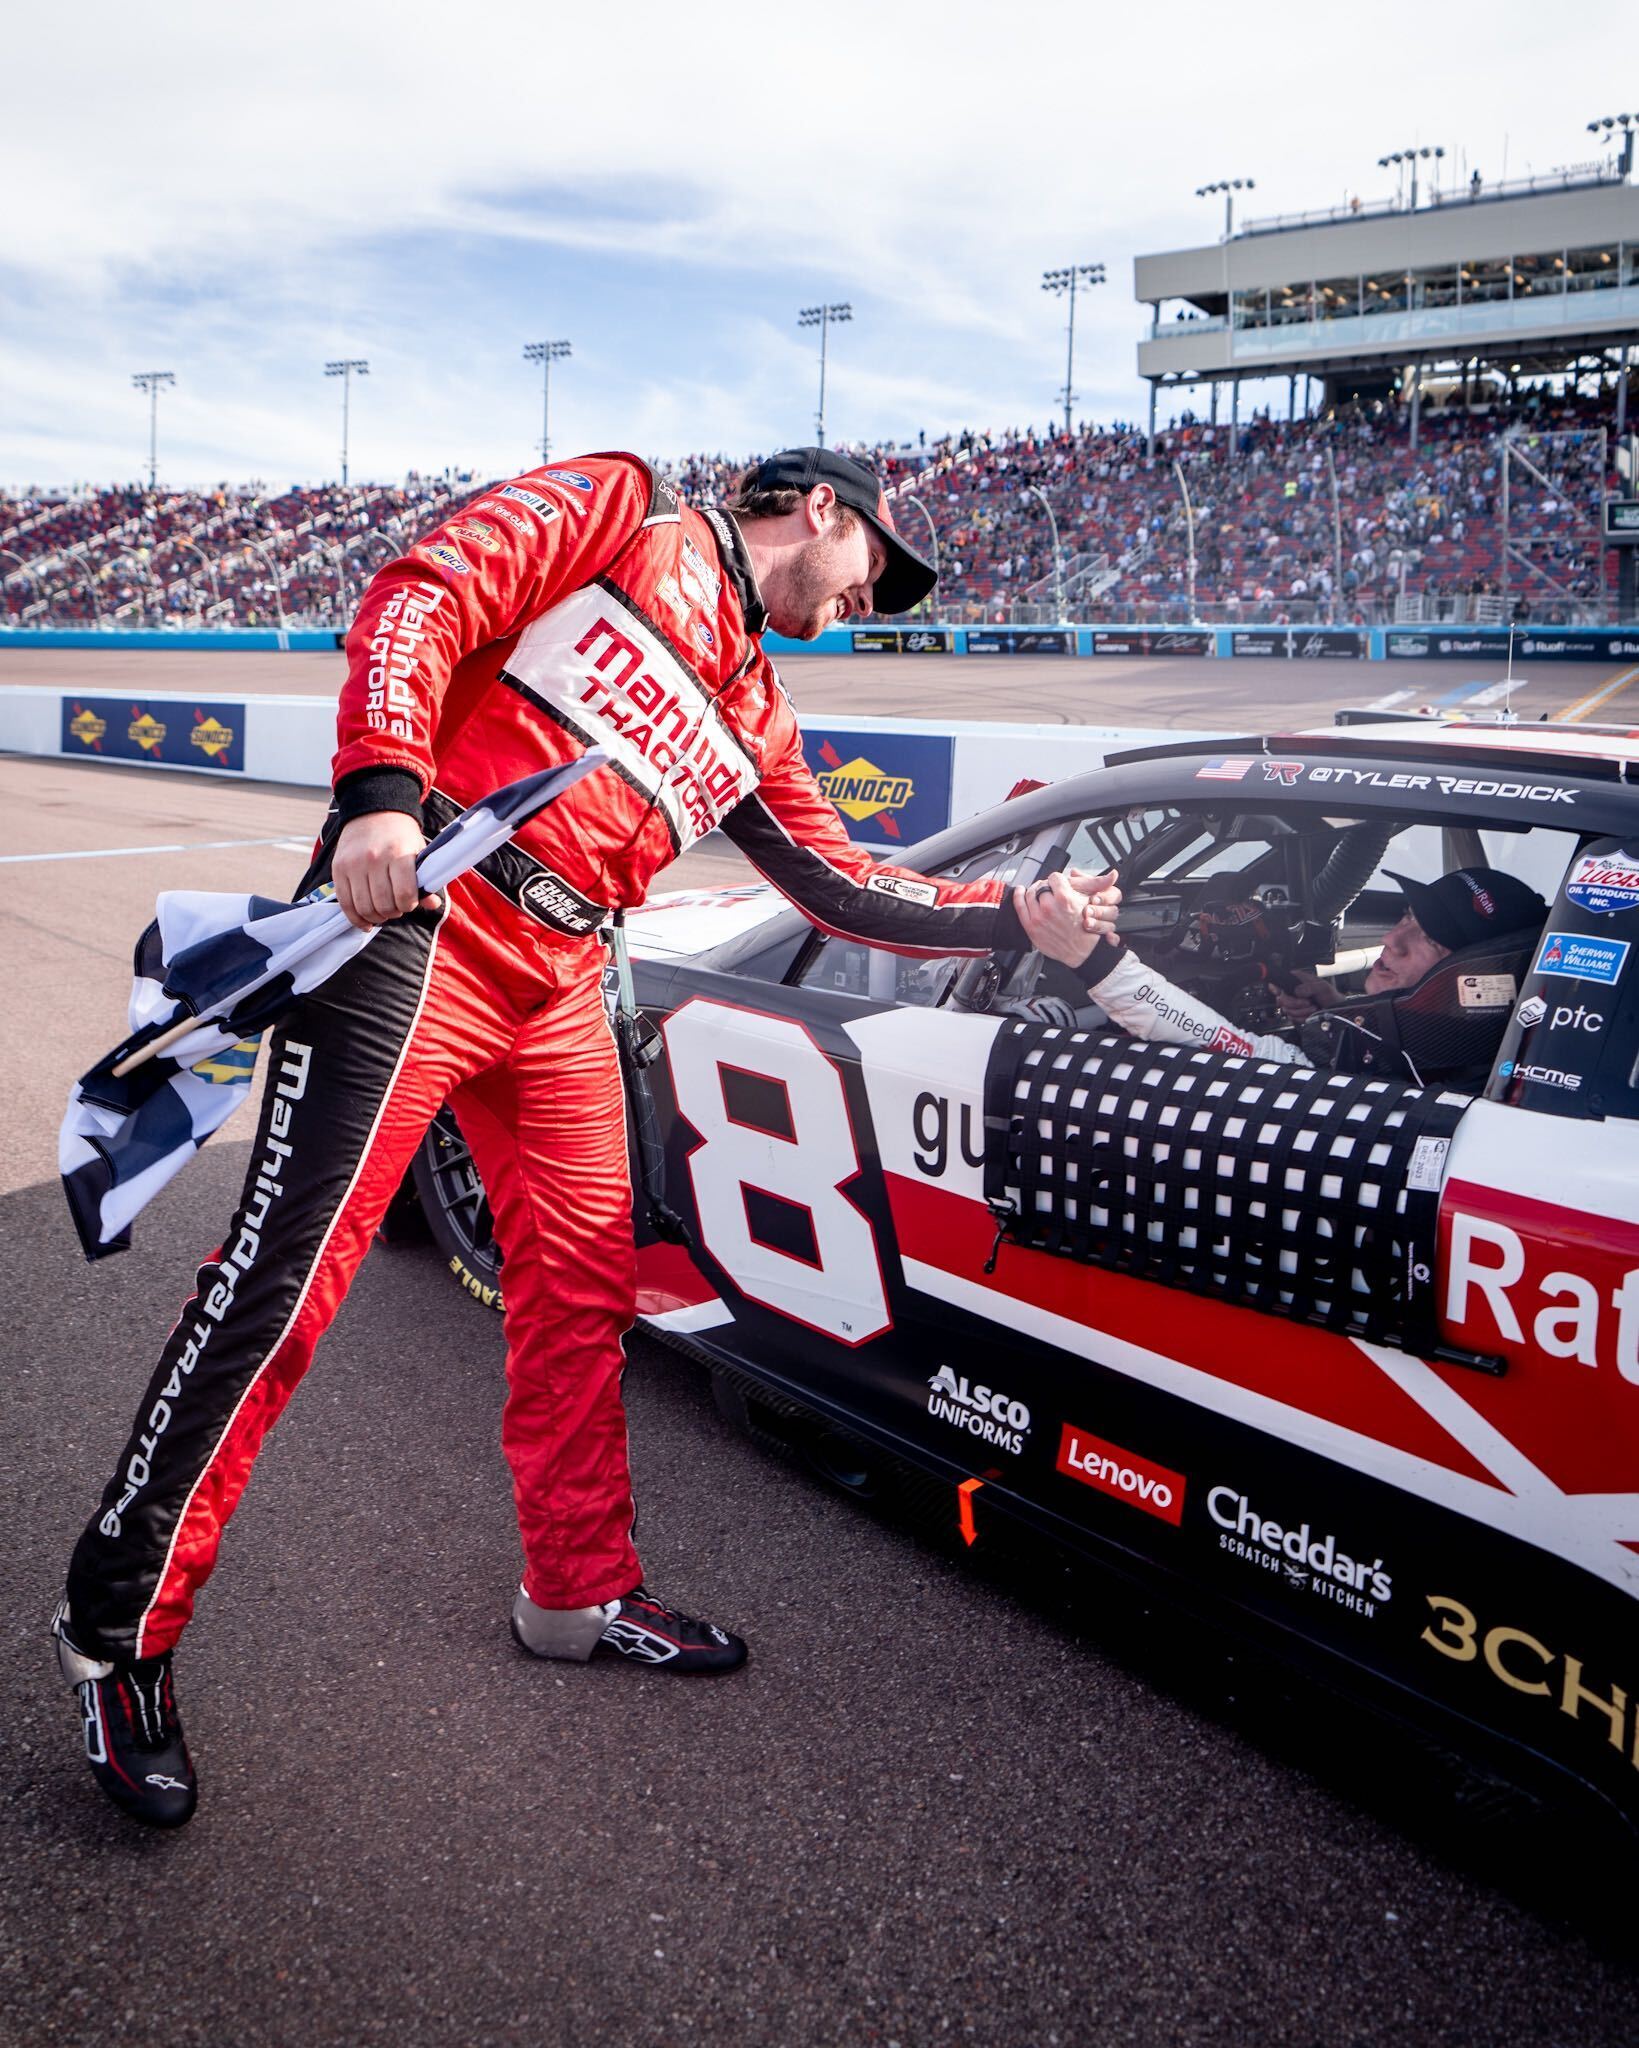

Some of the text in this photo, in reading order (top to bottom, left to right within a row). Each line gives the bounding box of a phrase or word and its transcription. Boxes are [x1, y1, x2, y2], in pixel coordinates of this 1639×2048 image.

[501, 486, 540, 506] Mobil
[366, 587, 409, 730] TRACTORS
[818, 776, 909, 804] SUNOCO
[538, 880, 581, 914] CHASE
[1568, 886, 1584, 894] OIL
[1563, 955, 1612, 970] WILLIAMS
[1567, 944, 1616, 960] SHERWIN
[1549, 1005, 1603, 1032] ptc
[1513, 1063, 1583, 1088] KCMG
[661, 995, 893, 1348] 8
[449, 1256, 507, 1312] EAGLE
[927, 1394, 1024, 1455] UNIFORMS
[928, 1364, 1031, 1431] ALSCO
[100, 1323, 212, 1538] TRACTORS
[1068, 1438, 1173, 1508] Lenovo
[1207, 1486, 1392, 1601] Cheddar's
[1219, 1534, 1375, 1619] SCRATCH KITCHEN
